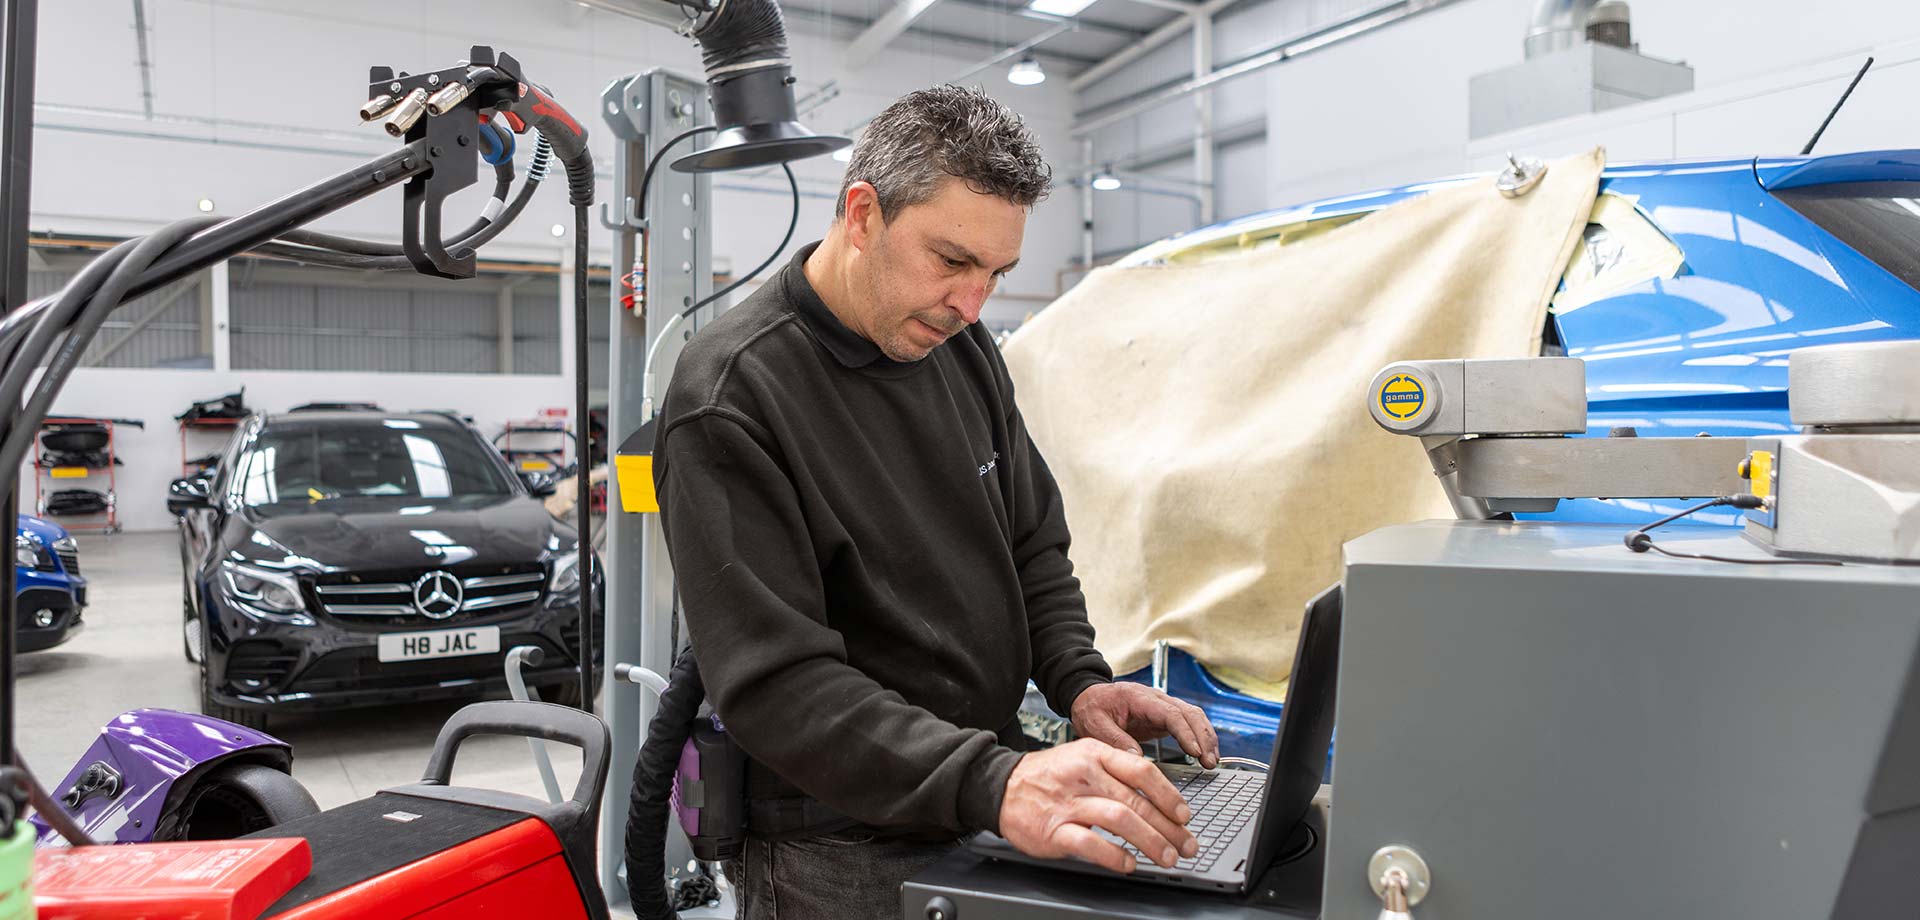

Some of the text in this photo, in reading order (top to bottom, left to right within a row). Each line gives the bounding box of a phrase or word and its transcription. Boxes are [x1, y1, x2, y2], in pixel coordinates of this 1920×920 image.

[1385, 393, 1419, 402] gamma
[403, 633, 478, 655] H8 JAC
